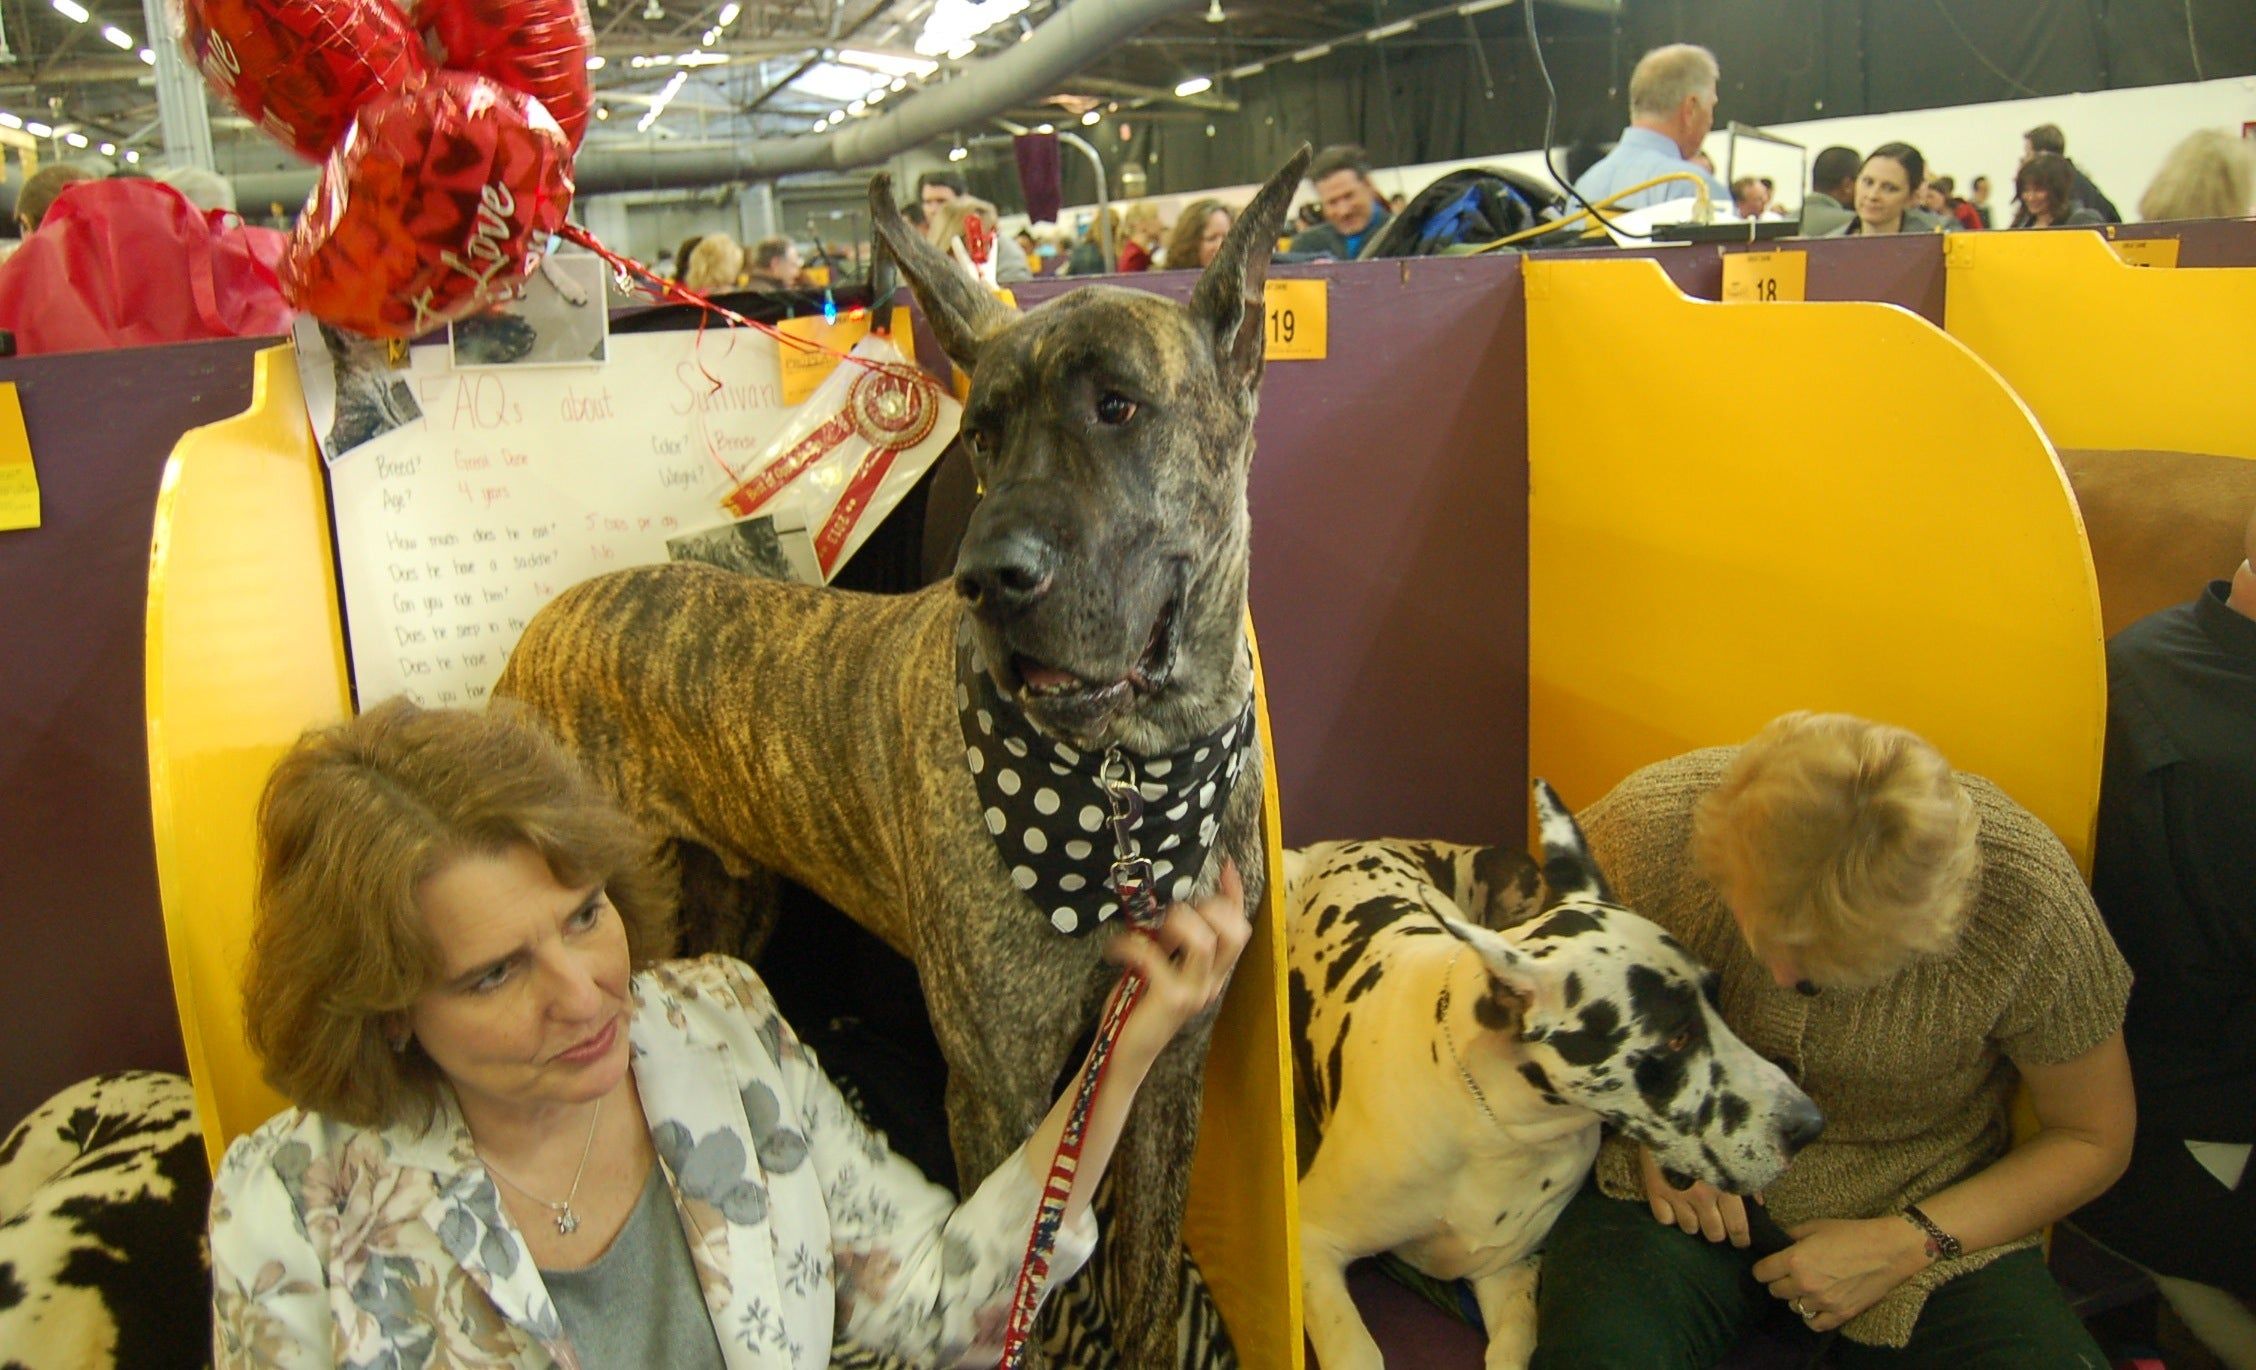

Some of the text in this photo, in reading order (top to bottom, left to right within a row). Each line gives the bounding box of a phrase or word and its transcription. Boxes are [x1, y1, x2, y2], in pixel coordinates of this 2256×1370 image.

[440, 181, 516, 299] Love
[1757, 278, 1777, 302] 18
[1270, 309, 1296, 344] 19
[418, 373, 524, 432] FAQs
[560, 385, 616, 424] about
[457, 480, 474, 504] 4
